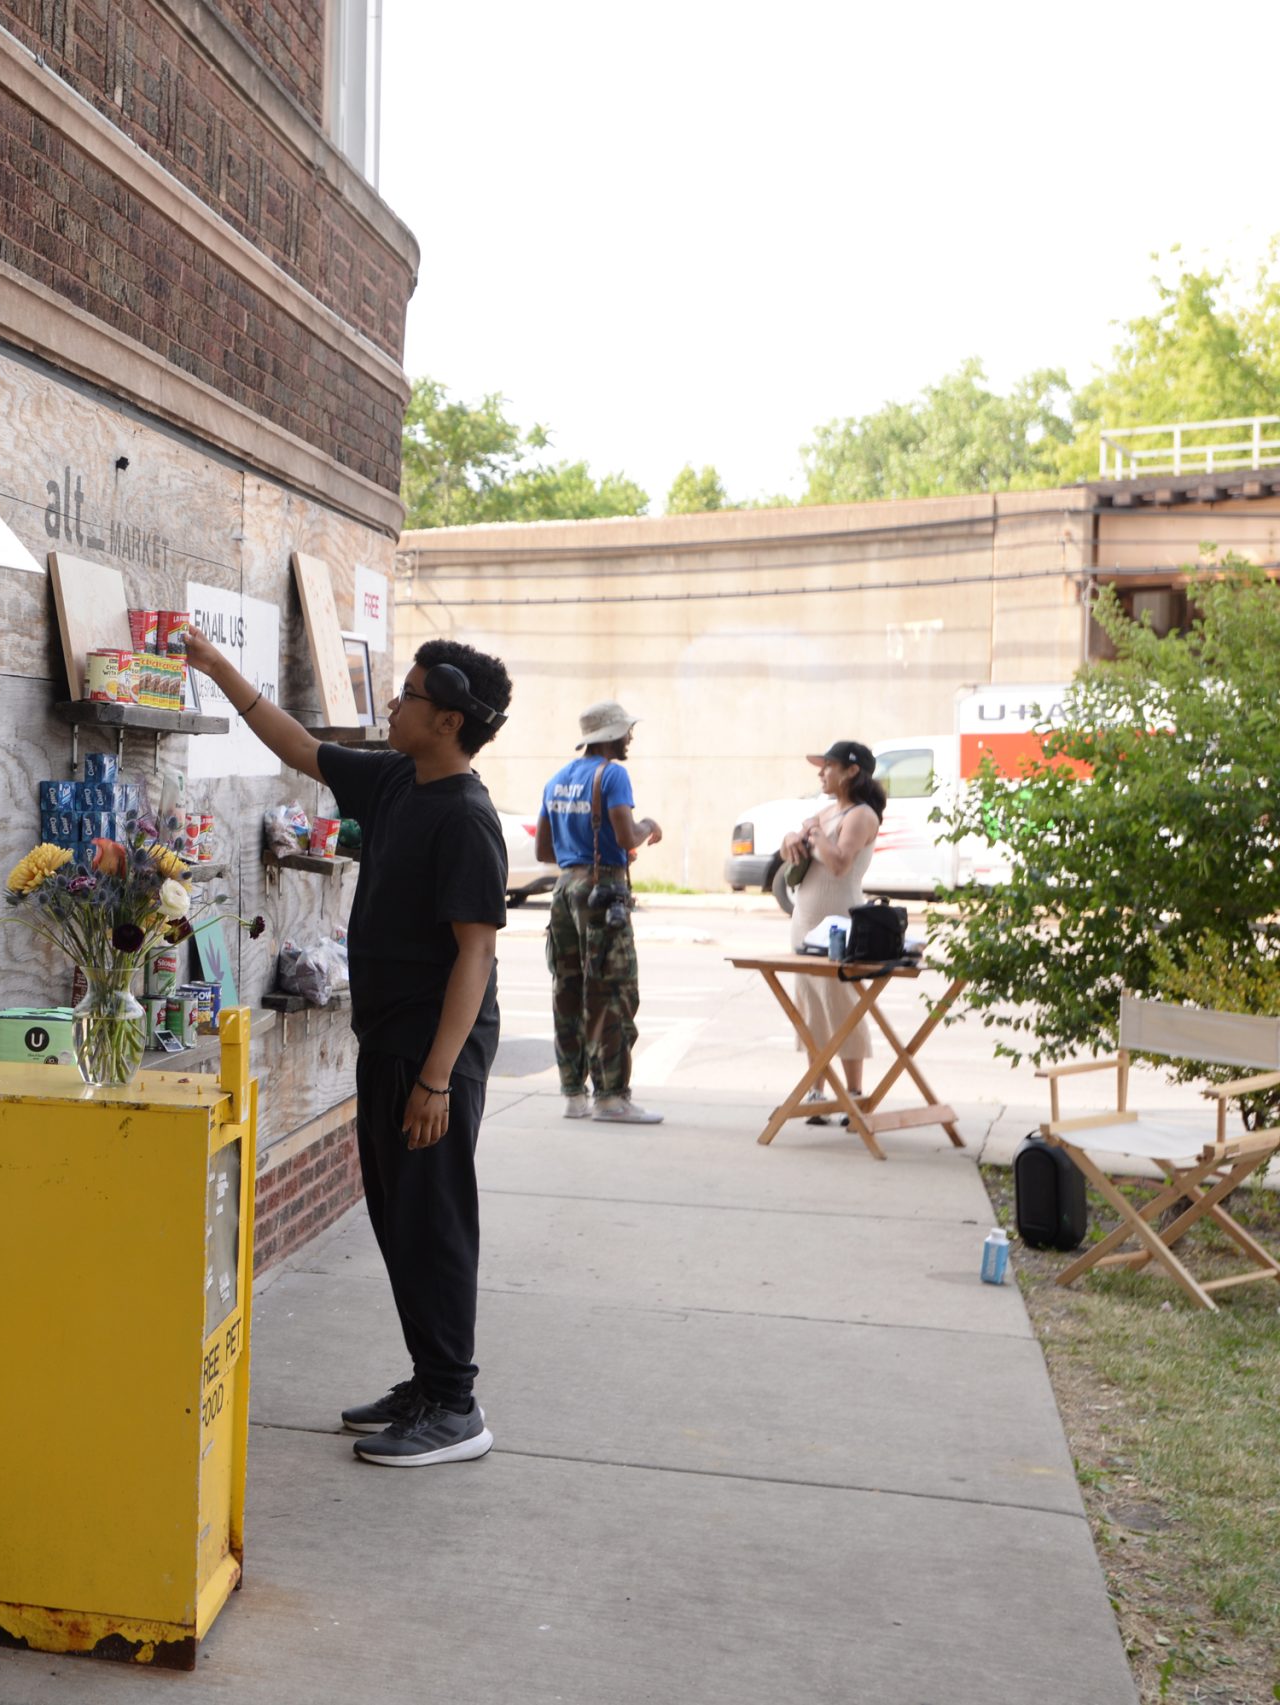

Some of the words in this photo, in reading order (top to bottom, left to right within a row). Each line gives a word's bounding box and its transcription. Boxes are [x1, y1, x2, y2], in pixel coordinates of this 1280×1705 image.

[110, 521, 170, 573] MARKET
[194, 609, 226, 644] EMAIL
[31, 1032, 43, 1048] U
[203, 1342, 220, 1388] REE
[225, 1317, 241, 1362] PET
